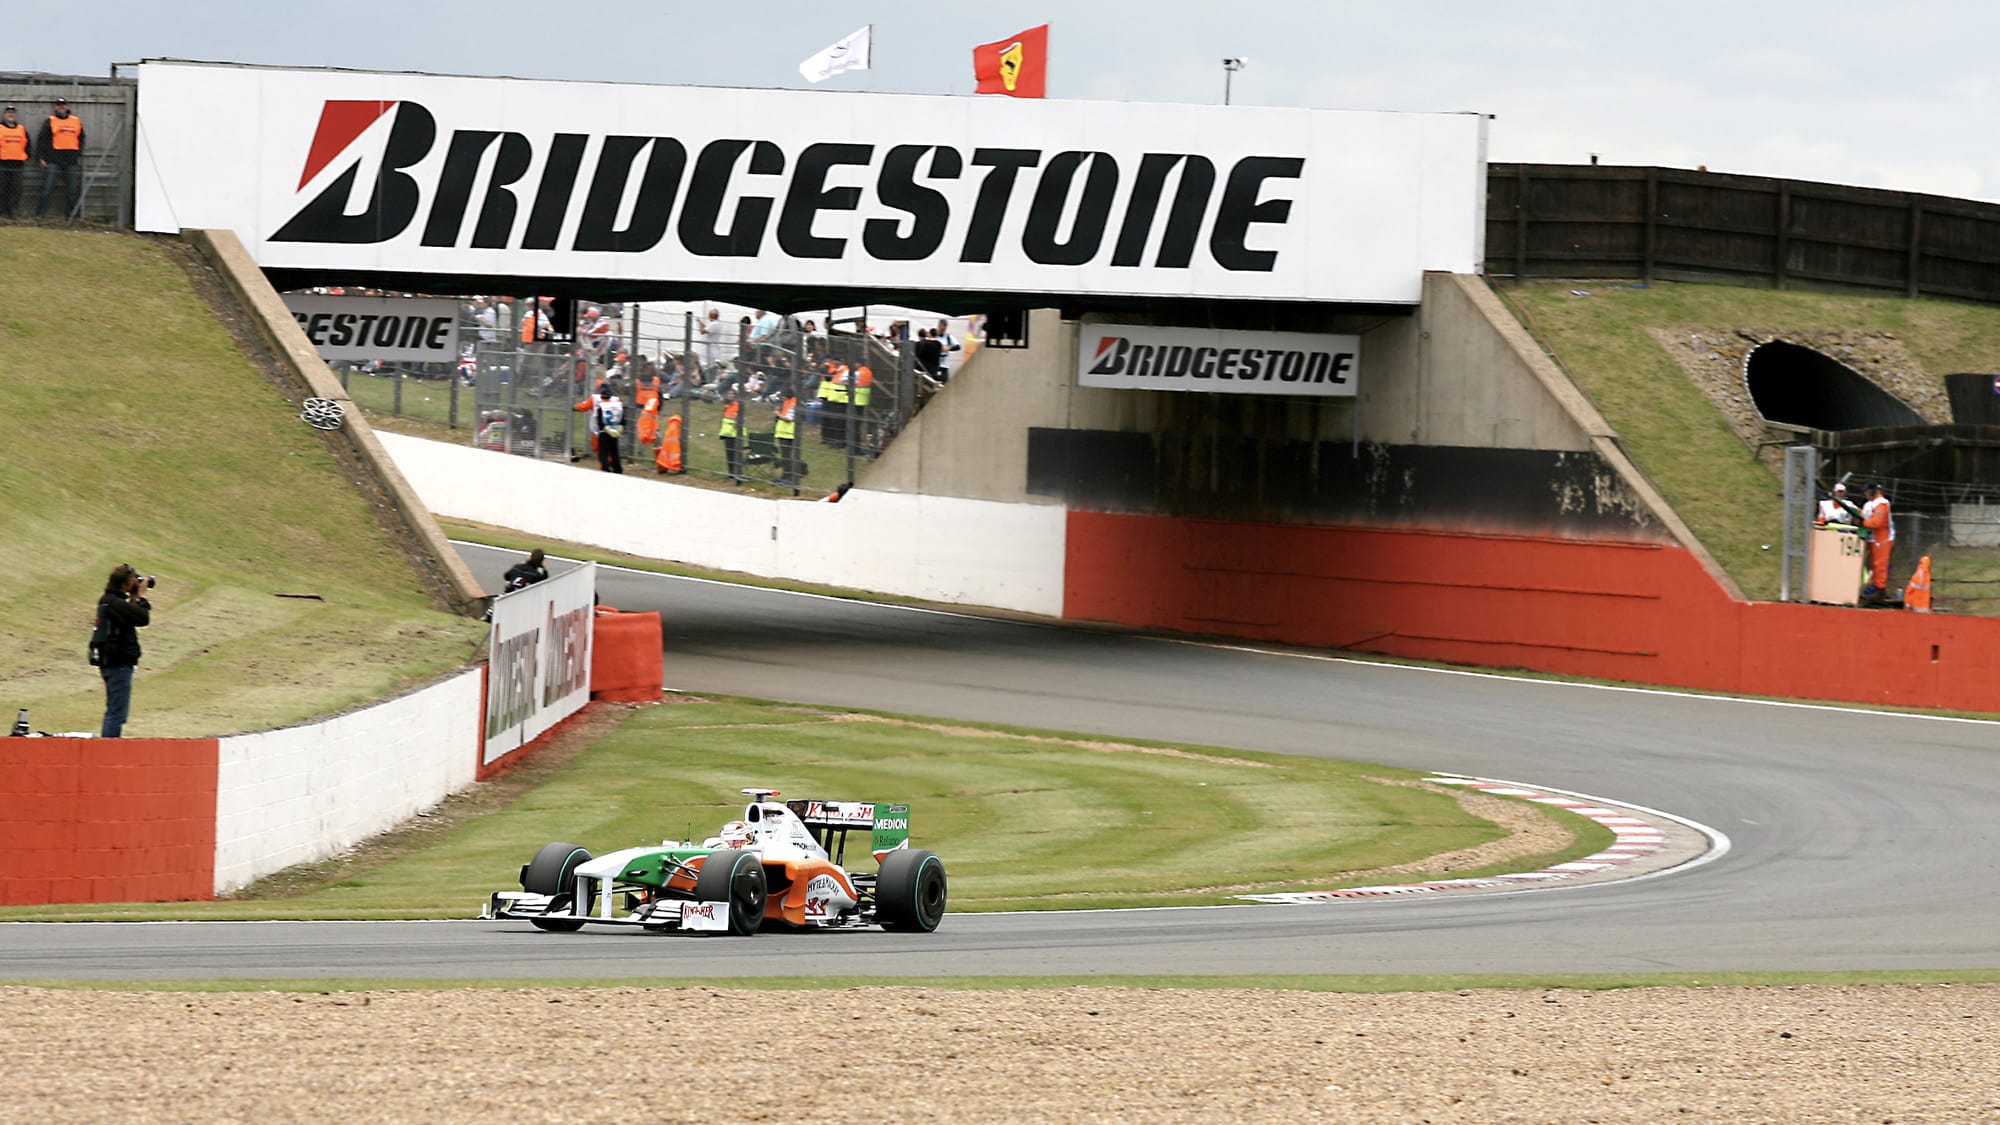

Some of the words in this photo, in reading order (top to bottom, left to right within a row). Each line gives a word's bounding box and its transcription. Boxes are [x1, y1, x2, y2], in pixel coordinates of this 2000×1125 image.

[266, 100, 1305, 273] BRIDGESTONE
[1087, 336, 1354, 384] BRIDGESTONE
[874, 818, 907, 830] MEDION
